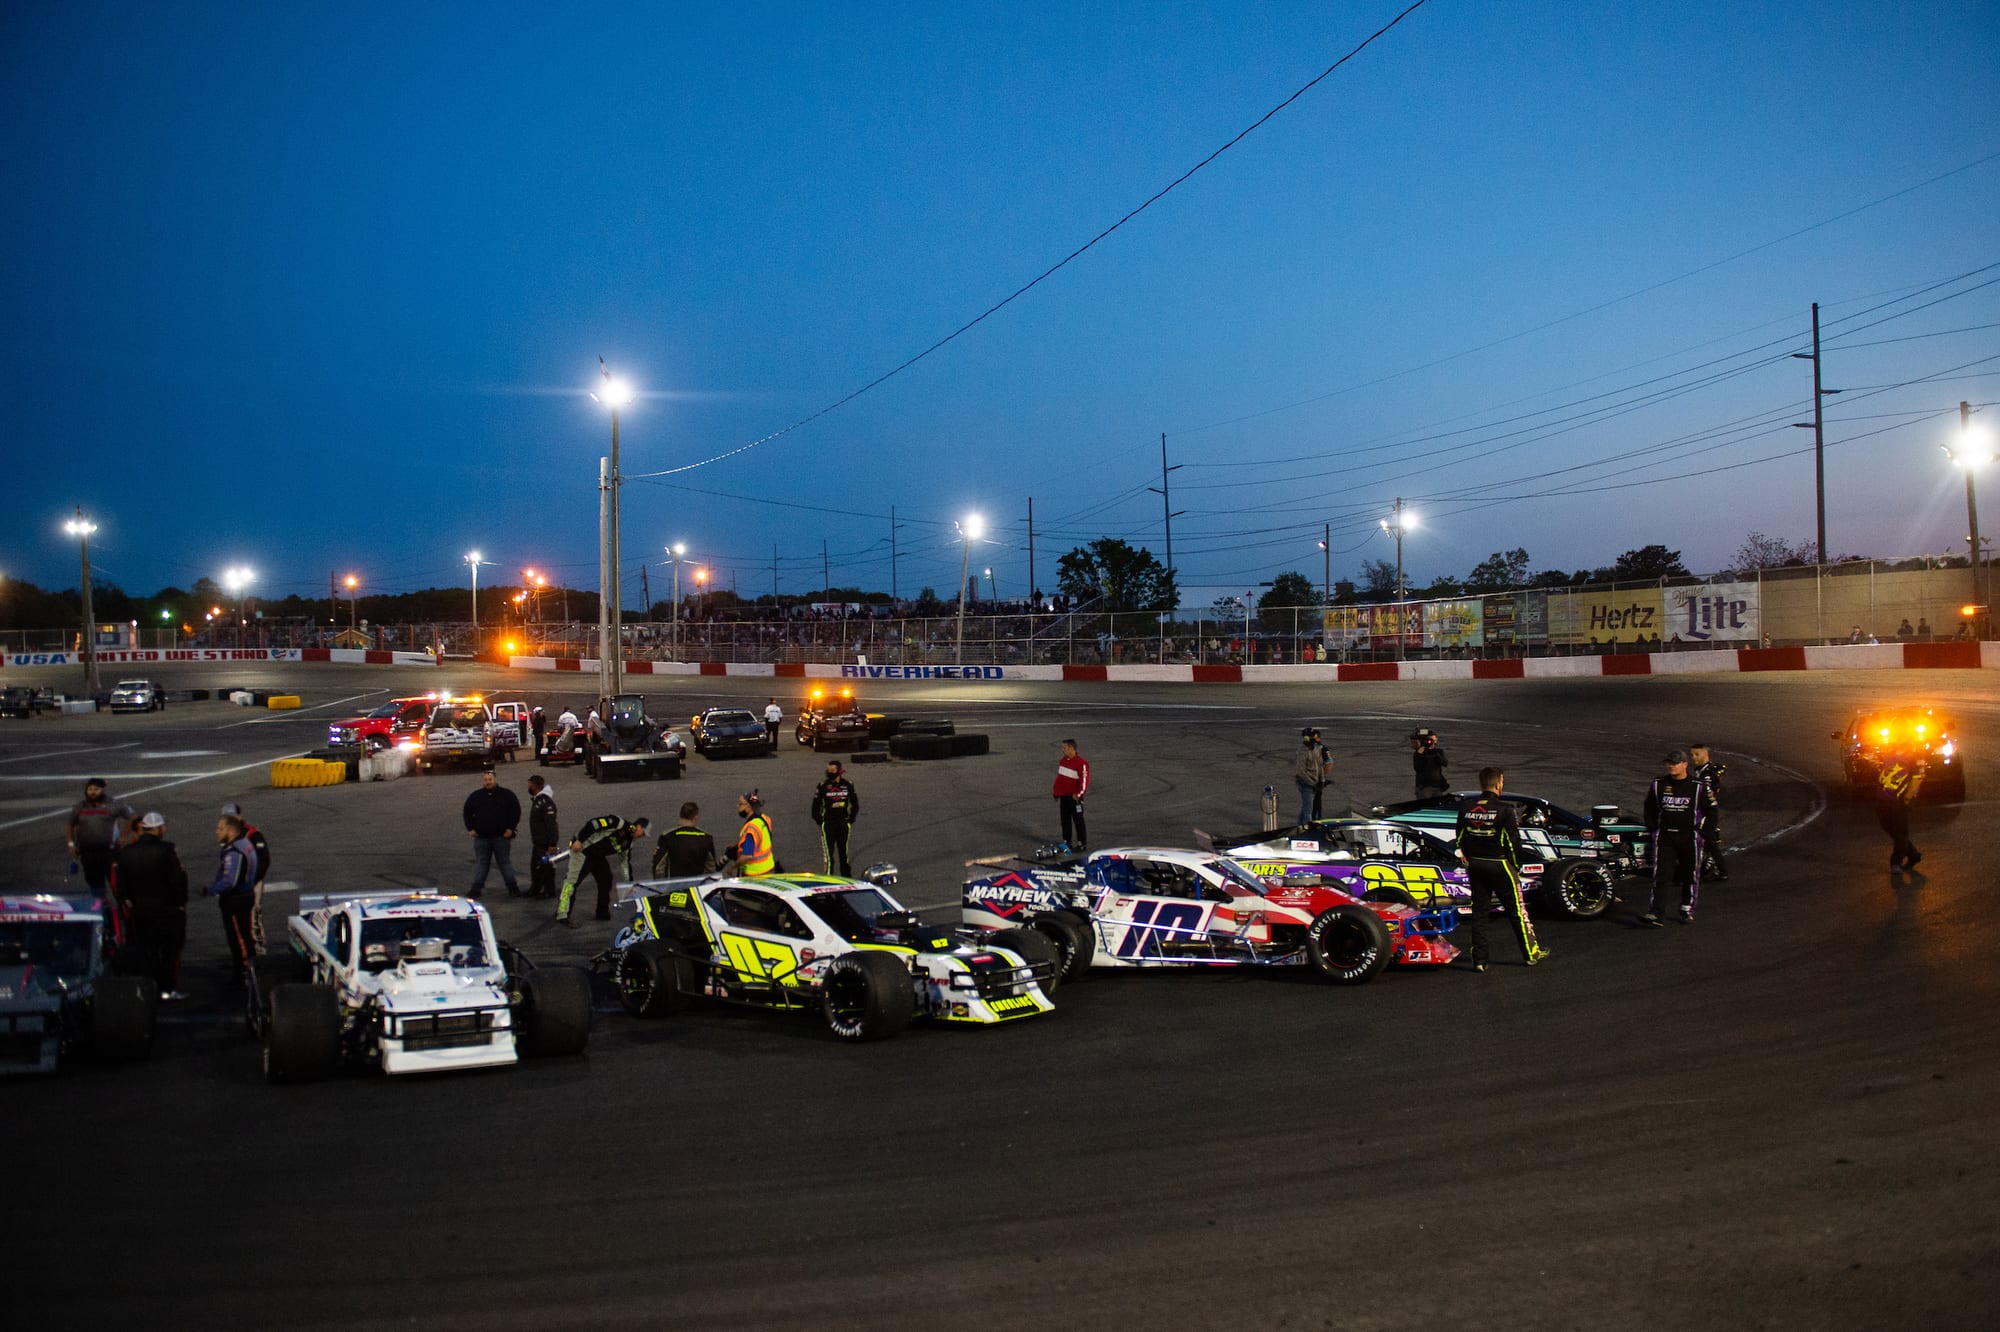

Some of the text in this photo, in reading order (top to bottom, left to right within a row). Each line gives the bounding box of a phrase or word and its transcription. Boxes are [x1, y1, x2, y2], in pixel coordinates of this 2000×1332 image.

[1672, 586, 1707, 607] Miller
[1590, 603, 1655, 630] Hertz
[1686, 594, 1747, 639] Lite
[14, 653, 67, 665] USA
[166, 650, 200, 661] WE
[203, 649, 268, 661] STAND
[841, 665, 1003, 679] RIVERHEAD
[1464, 812, 1497, 821] MAYHEW
[1595, 866, 1614, 900] Hoosier
[971, 885, 1052, 903] MAYHEW
[1561, 879, 1577, 913] Hoosier
[1309, 912, 1342, 941] Hoosier
[1344, 947, 1378, 979] Hoosier
[1409, 951, 1430, 961] JE
